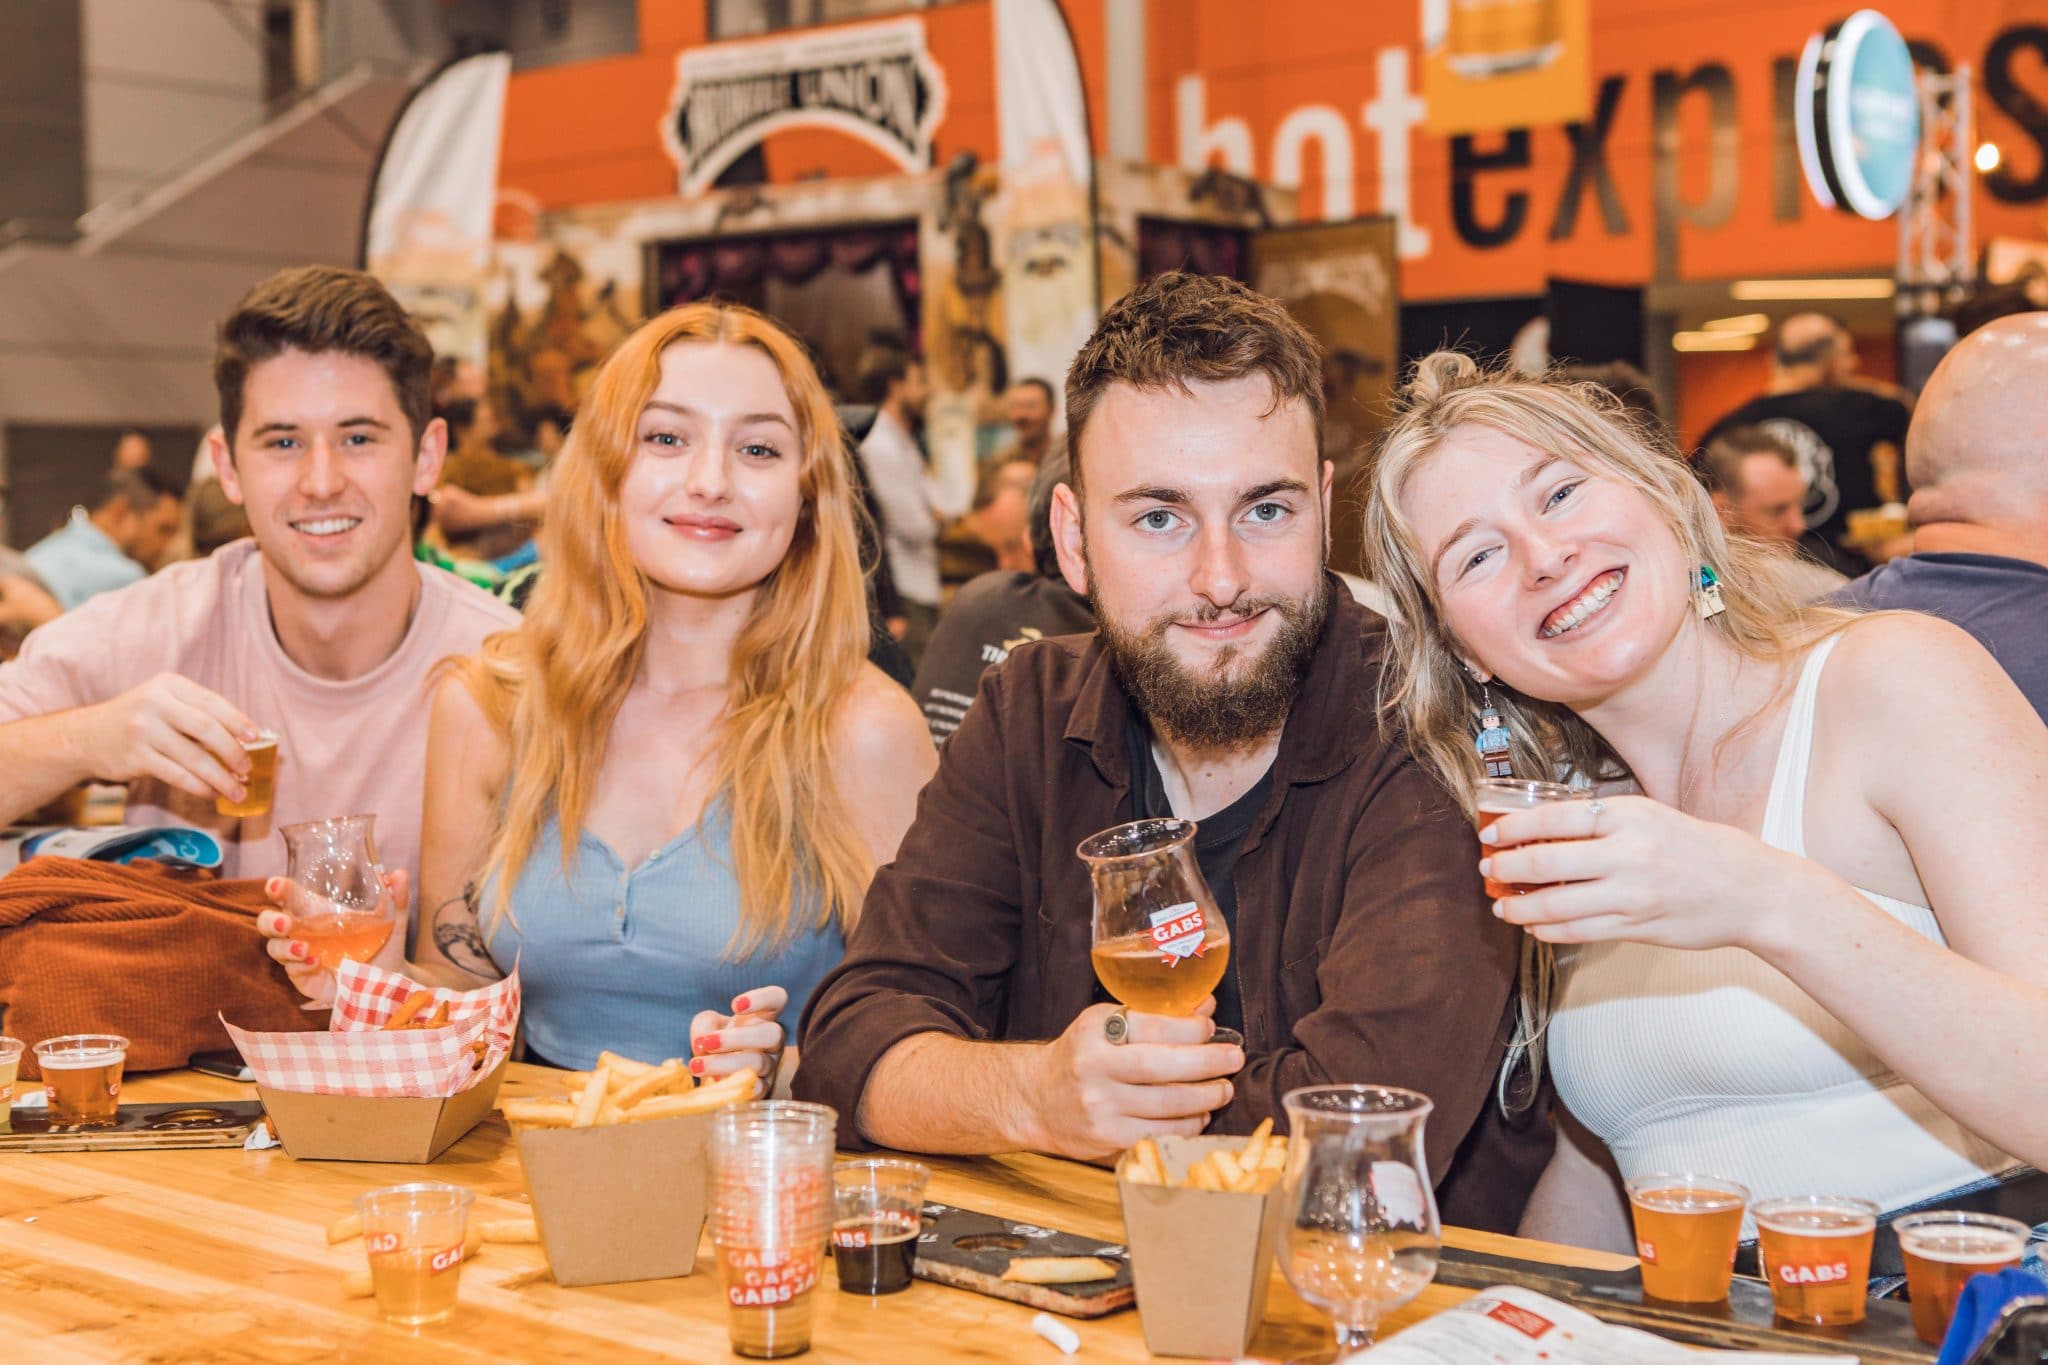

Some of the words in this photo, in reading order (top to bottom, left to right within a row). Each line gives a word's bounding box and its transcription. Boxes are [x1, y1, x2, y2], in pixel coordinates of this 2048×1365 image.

[1152, 912, 1204, 943] GABS
[1779, 1261, 1849, 1284] GABS
[728, 1282, 793, 1306] GABS
